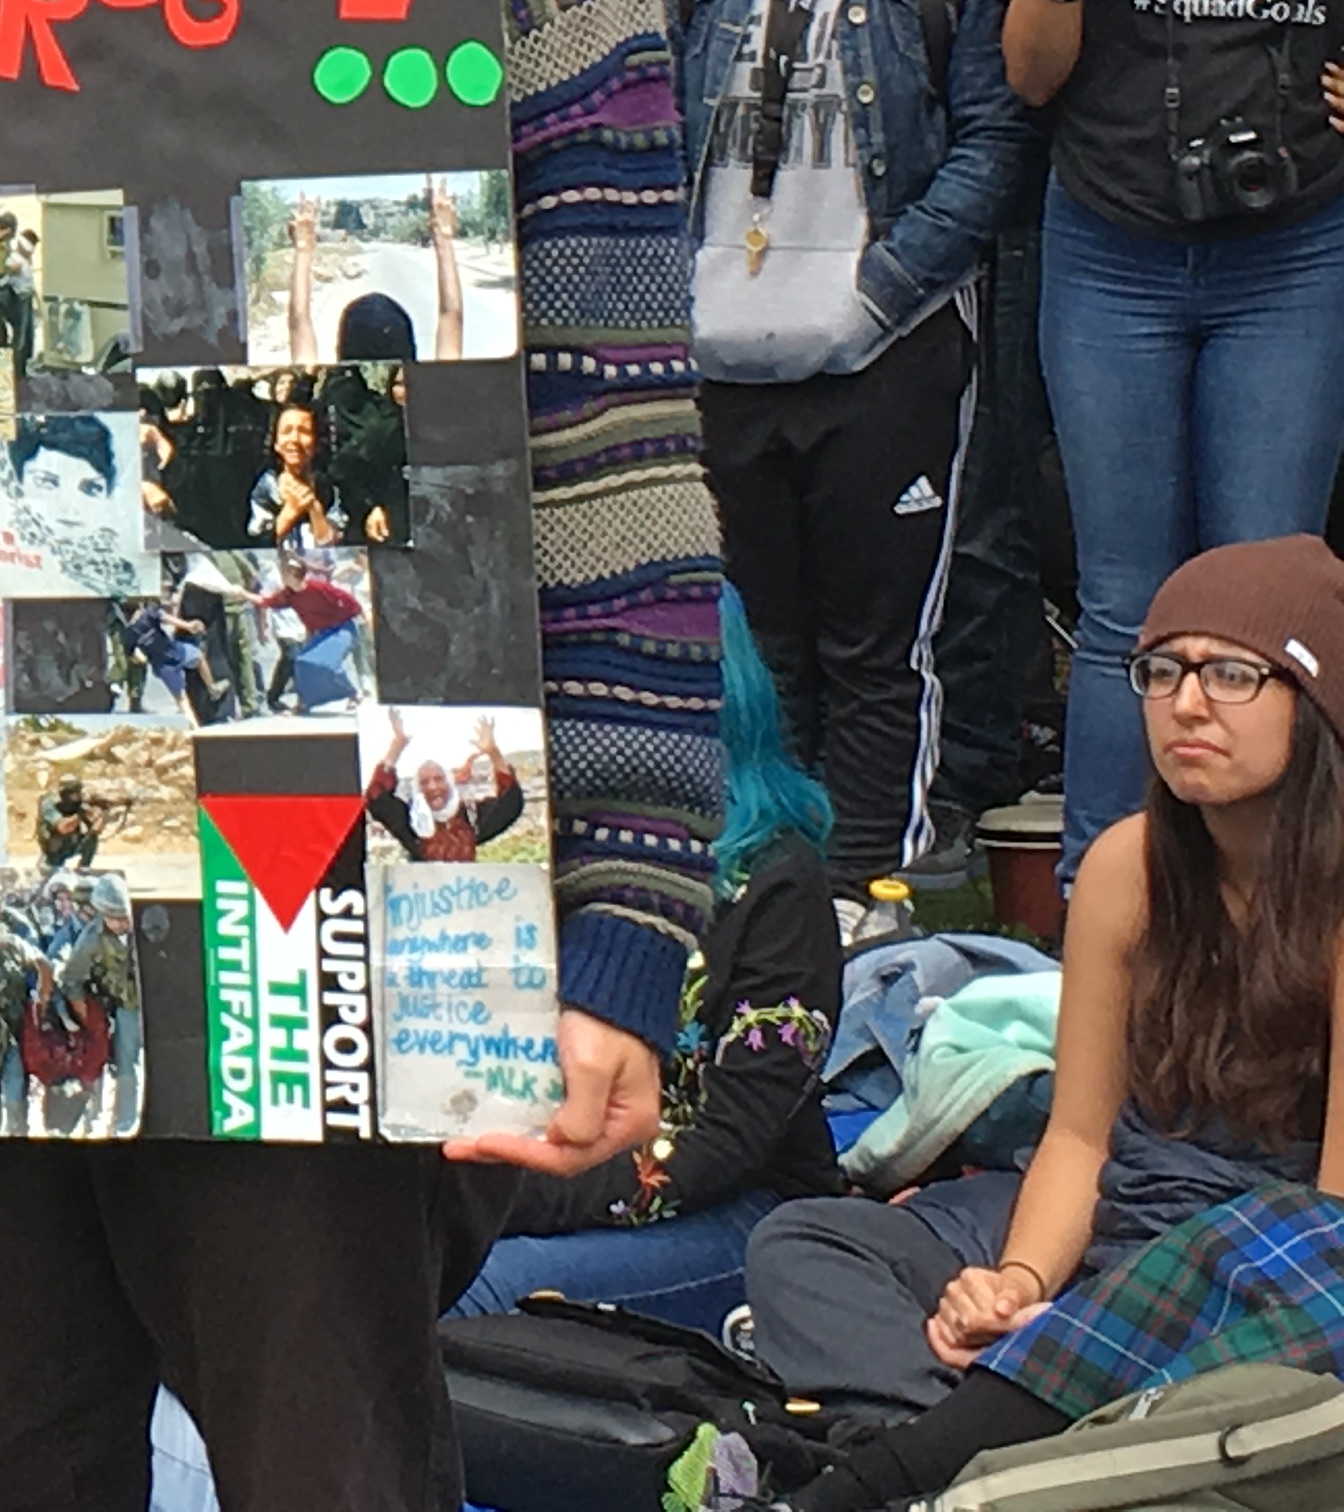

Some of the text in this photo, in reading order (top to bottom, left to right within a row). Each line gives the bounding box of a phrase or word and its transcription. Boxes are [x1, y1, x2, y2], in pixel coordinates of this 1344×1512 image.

[406, 960, 489, 989] threat
[511, 954, 548, 990] to
[514, 914, 539, 950] is
[215, 879, 256, 1133] INTIFADA
[267, 968, 311, 1110] THE
[320, 886, 372, 1139] SUPPORT
